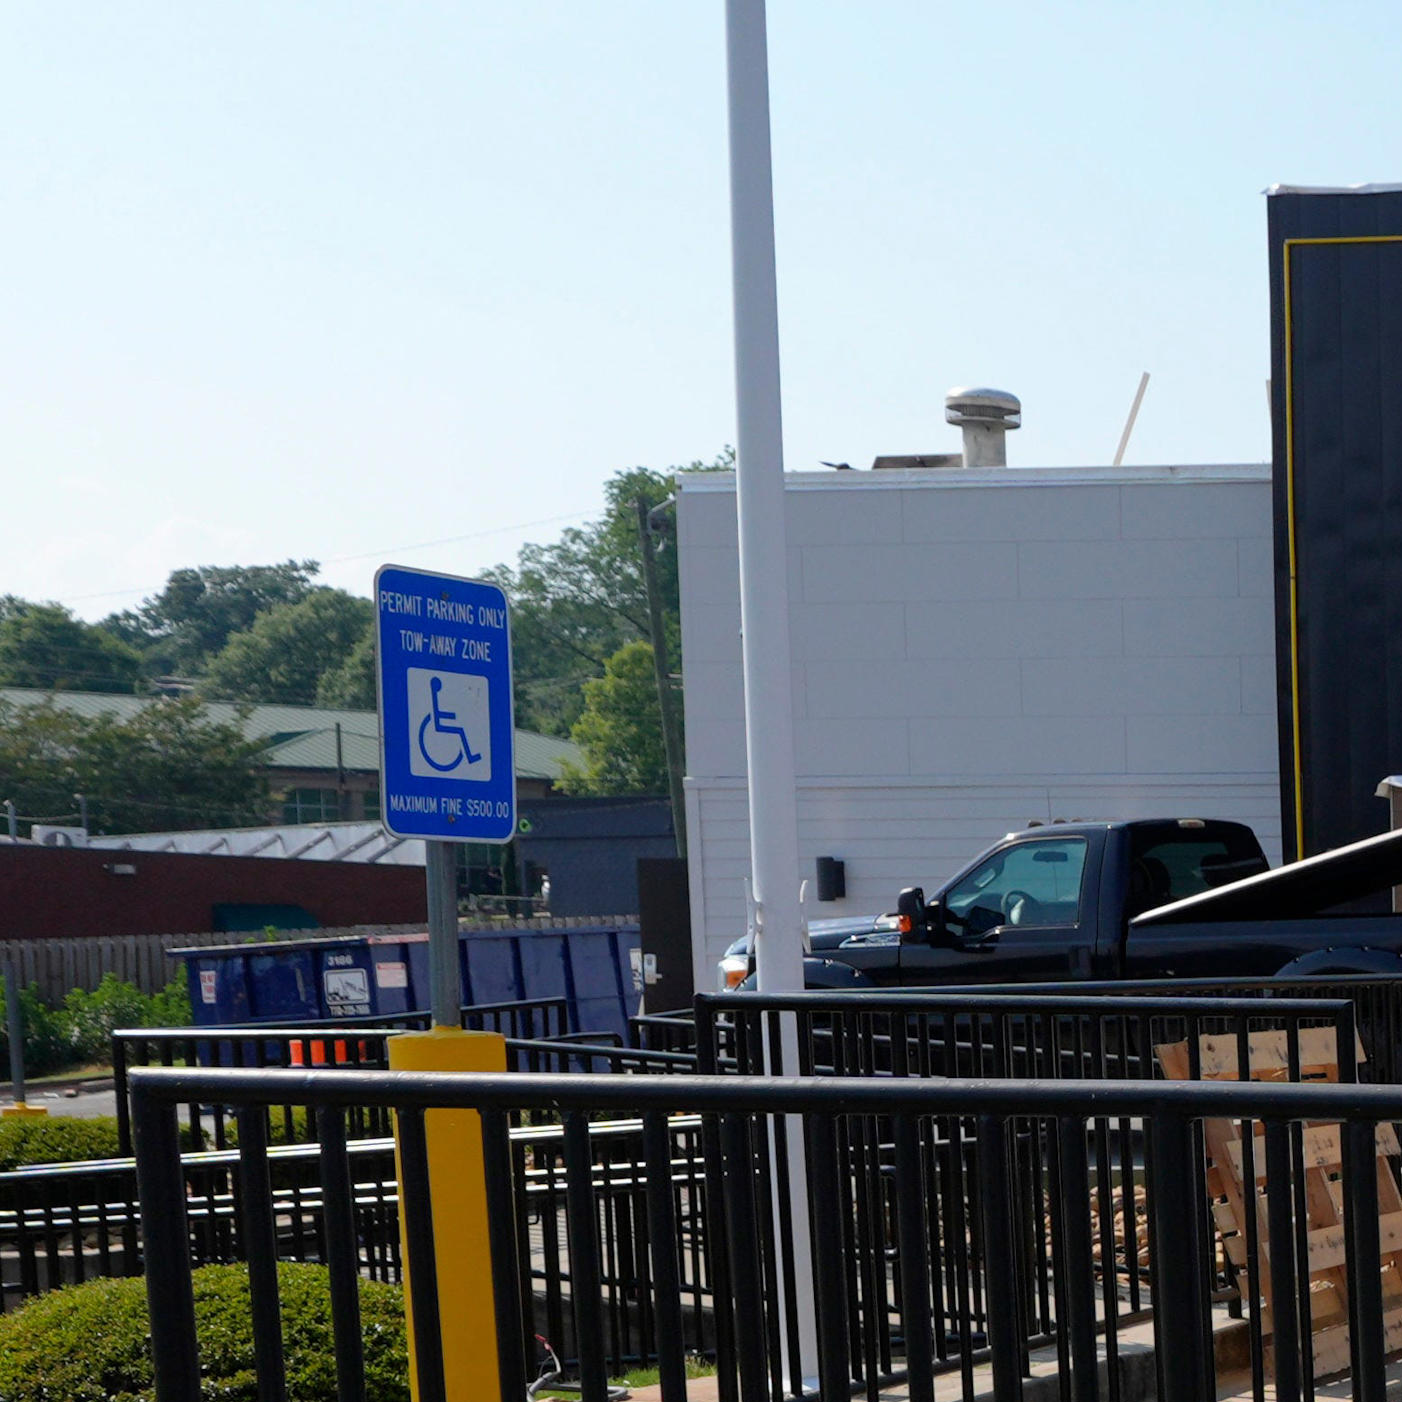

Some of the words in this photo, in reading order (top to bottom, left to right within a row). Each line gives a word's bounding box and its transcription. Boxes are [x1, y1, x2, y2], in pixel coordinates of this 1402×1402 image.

[380, 590, 423, 617] PERMIT
[426, 597, 475, 625] PARKING
[478, 606, 505, 629] ONLY
[399, 629, 457, 657] TOW-AWAY
[461, 638, 492, 662] ZONE
[390, 794, 438, 814] MAXIMUM
[441, 797, 463, 816] FINE
[466, 799, 509, 818] $500.00
